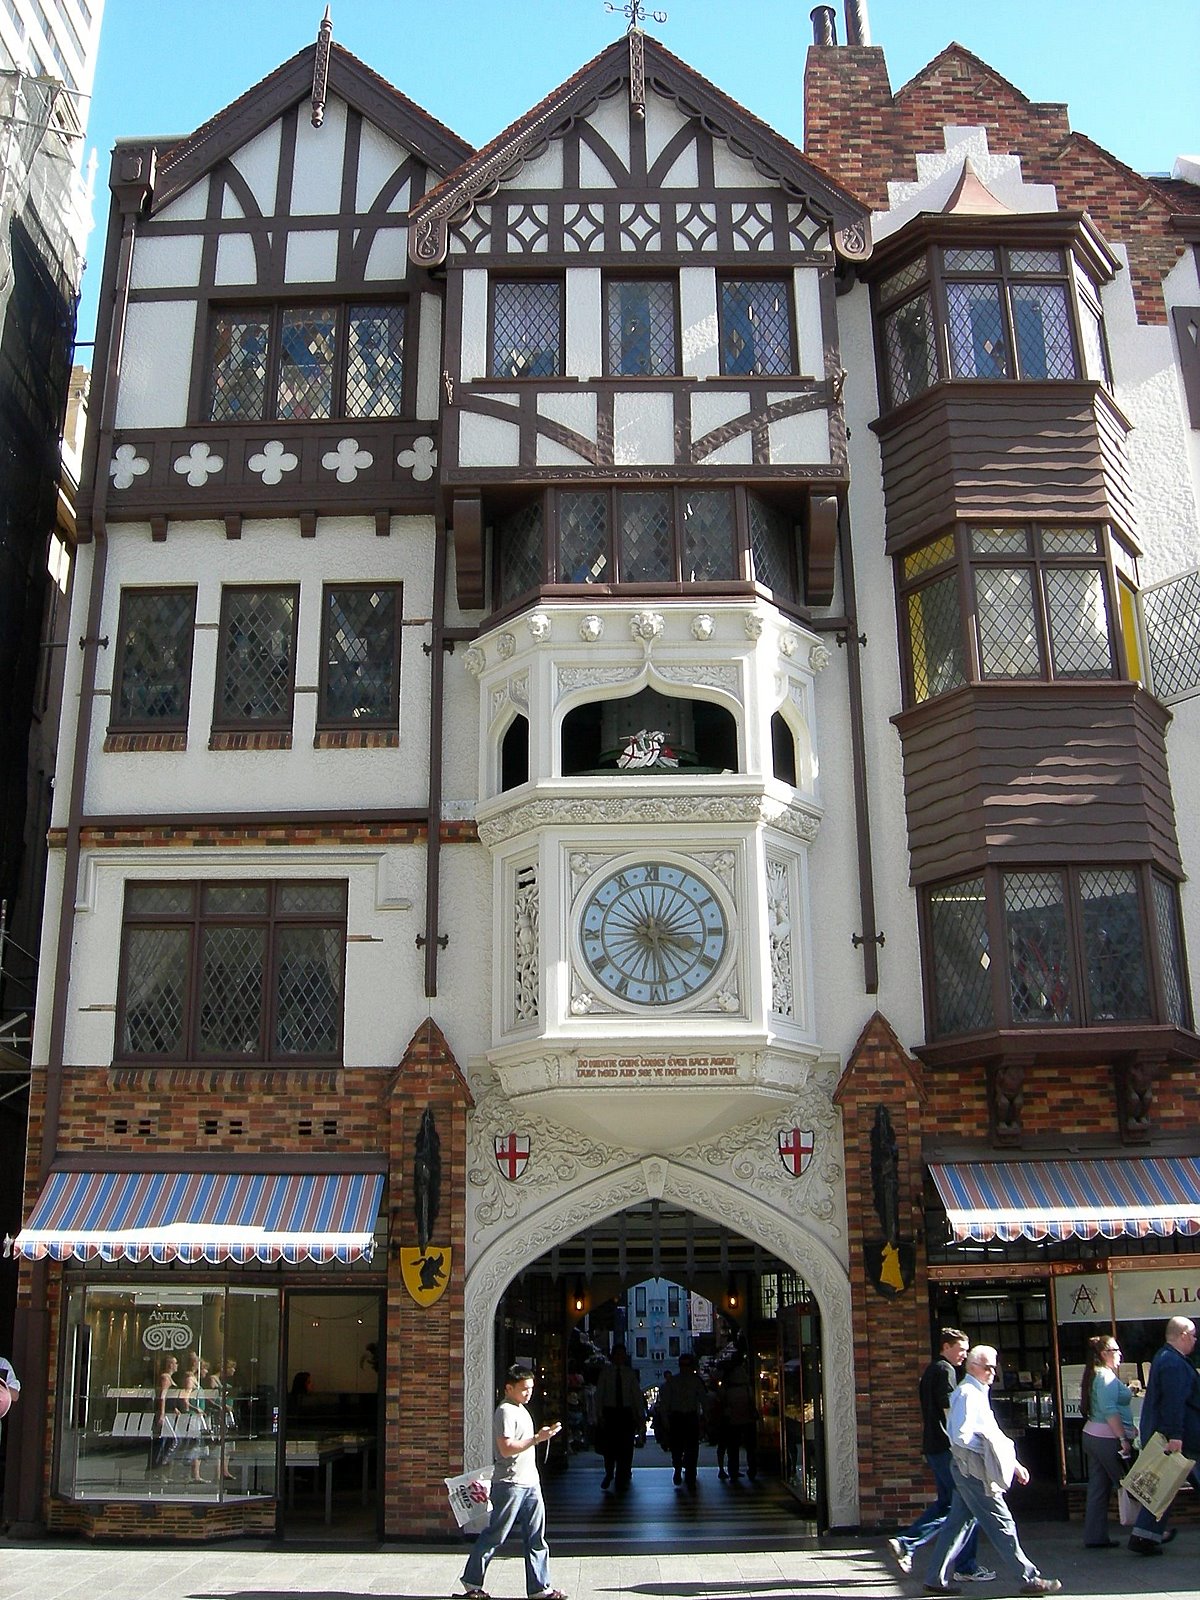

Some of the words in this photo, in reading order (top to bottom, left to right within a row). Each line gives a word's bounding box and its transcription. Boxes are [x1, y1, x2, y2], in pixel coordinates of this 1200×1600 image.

[618, 1059, 640, 1067] GONE
[640, 1058, 666, 1067] COMES
[667, 1057, 687, 1066] EVER
[689, 1057, 709, 1066] BACK
[710, 1057, 735, 1066] AGAIN
[576, 1069, 598, 1078] TAKE
[619, 1069, 637, 1077] AND
[638, 1068, 653, 1077] SEE
[653, 1068, 664, 1077] YE
[698, 1067, 709, 1076] DO
[709, 1067, 718, 1076] IN
[718, 1067, 737, 1076] VAIN
[1152, 1287, 1200, 1304] ALL
[148, 1309, 189, 1321] ANTIKA
